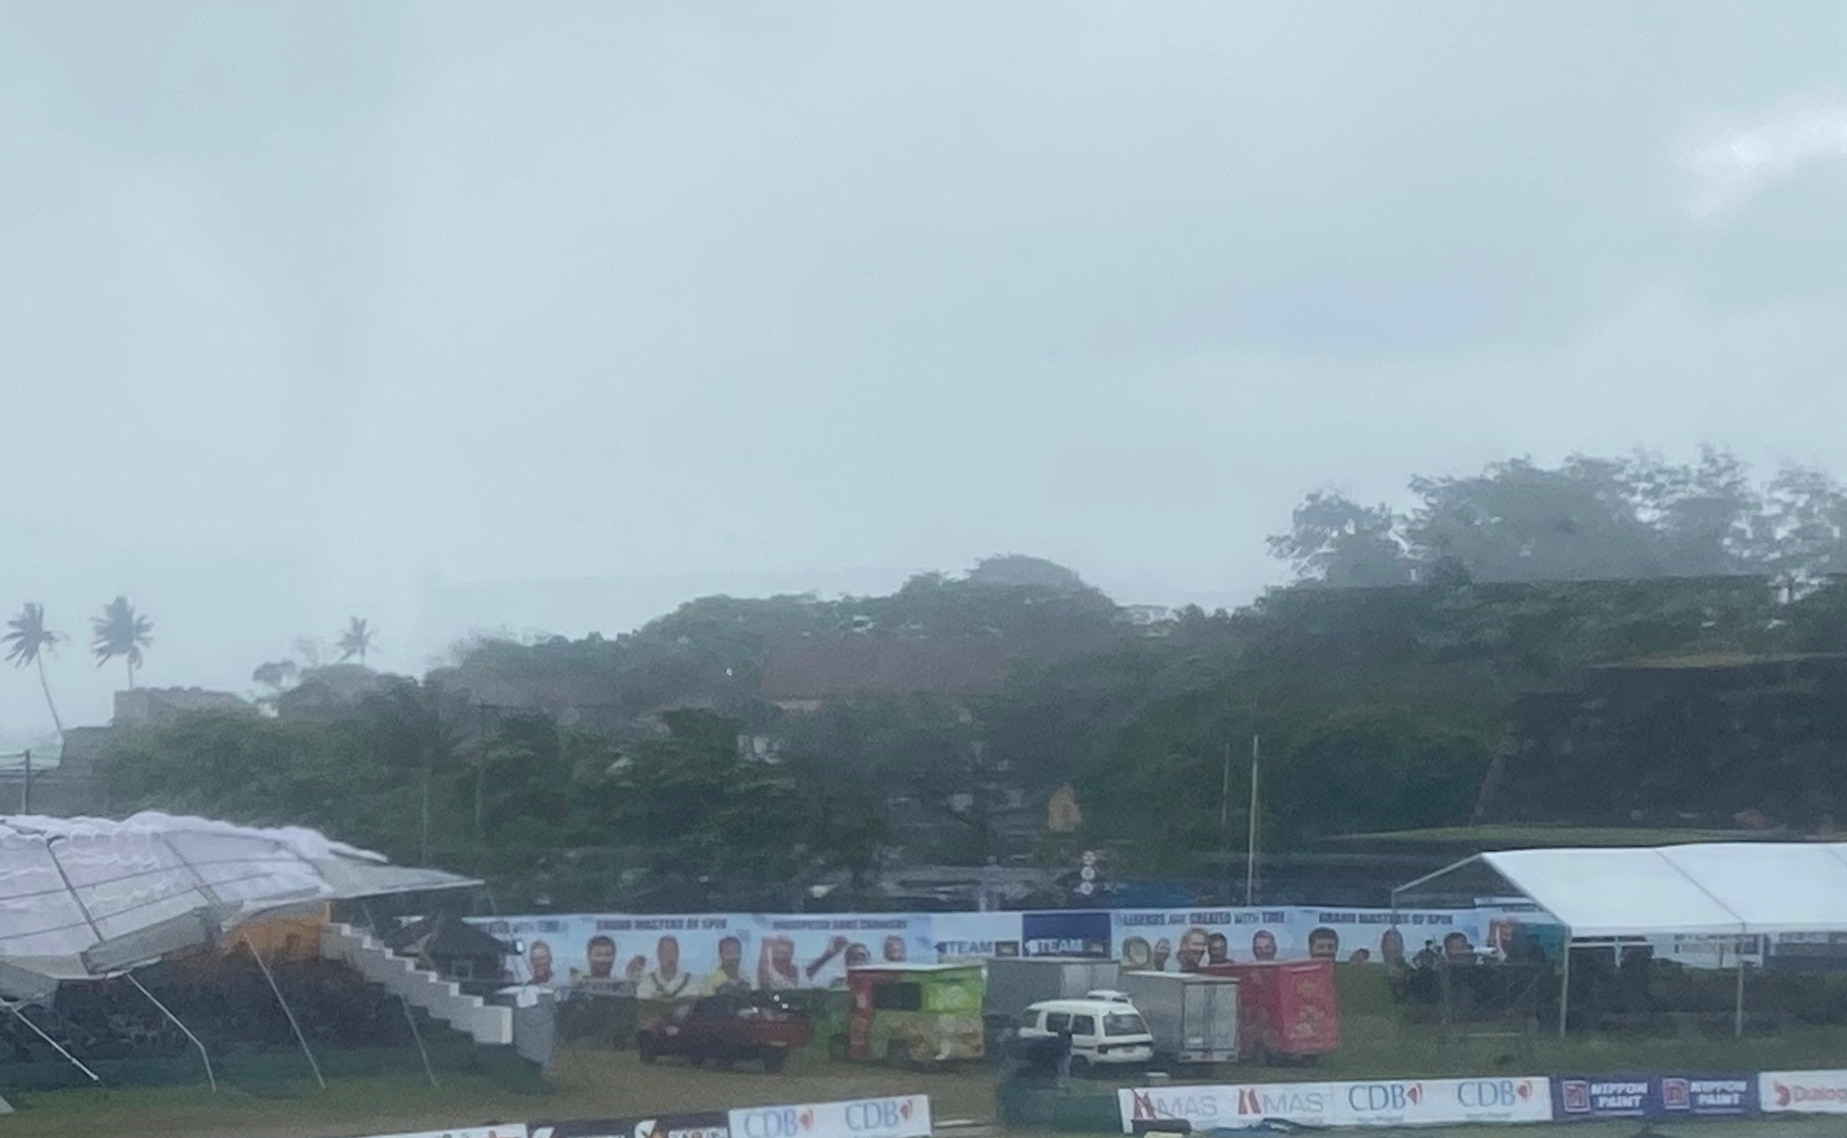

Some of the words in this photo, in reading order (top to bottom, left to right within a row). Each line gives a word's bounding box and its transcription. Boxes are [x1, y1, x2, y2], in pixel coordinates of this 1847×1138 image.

[1157, 1095, 1218, 1117] MAS
[1264, 1093, 1323, 1114] MAS
[1349, 1084, 1406, 1111] CDB
[1458, 1080, 1516, 1107] CDB
[744, 1109, 798, 1138] CDB
[846, 1101, 899, 1131] CDB
